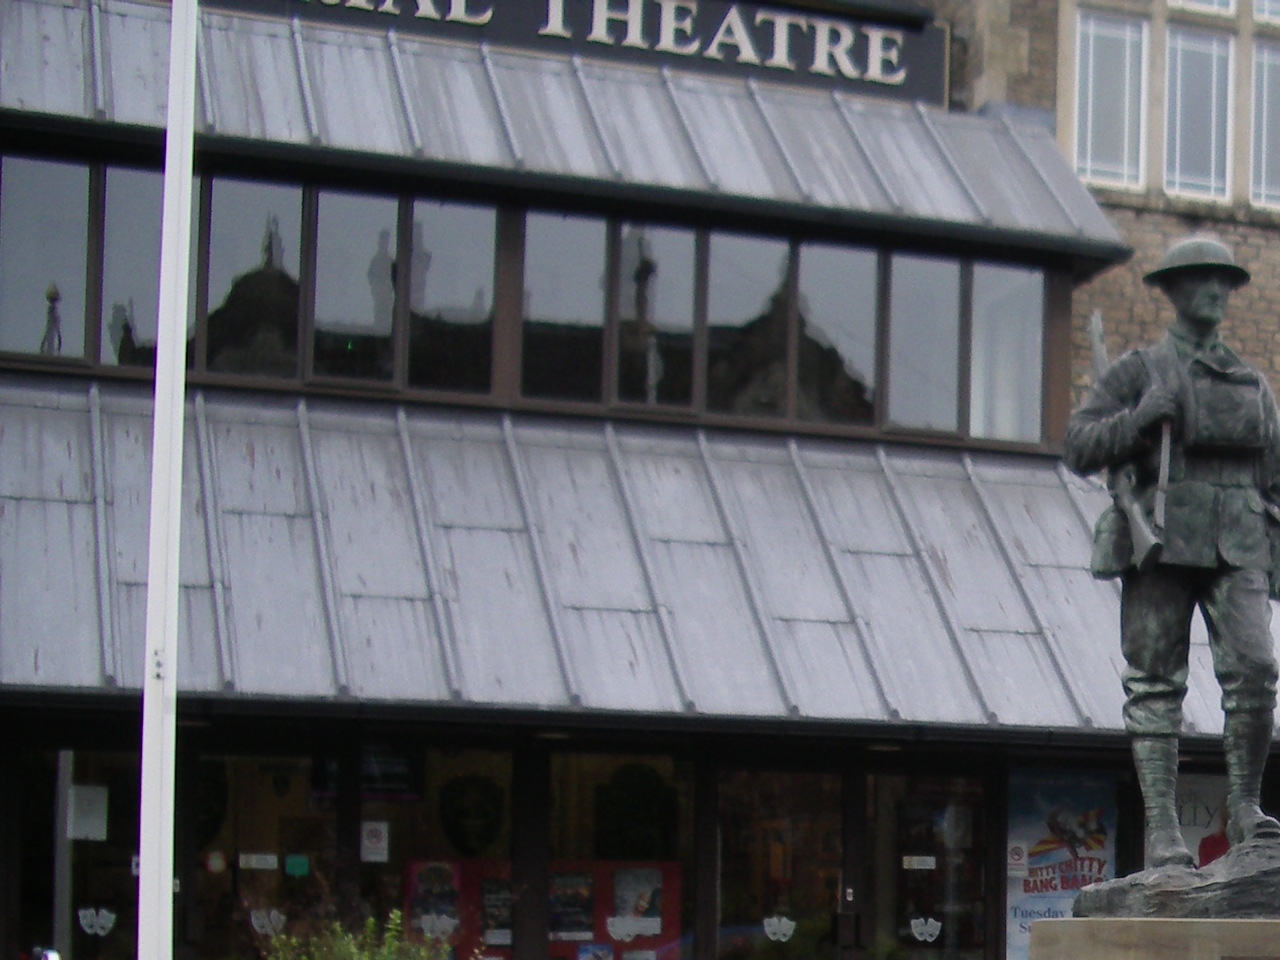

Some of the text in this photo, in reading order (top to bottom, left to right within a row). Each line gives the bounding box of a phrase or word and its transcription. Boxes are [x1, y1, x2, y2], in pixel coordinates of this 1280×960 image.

[538, 0, 906, 85] THEATRE
[1058, 857, 1107, 876] CHITTY
[1023, 876, 1058, 894] BANG
[1011, 906, 1067, 918] Tuesday
